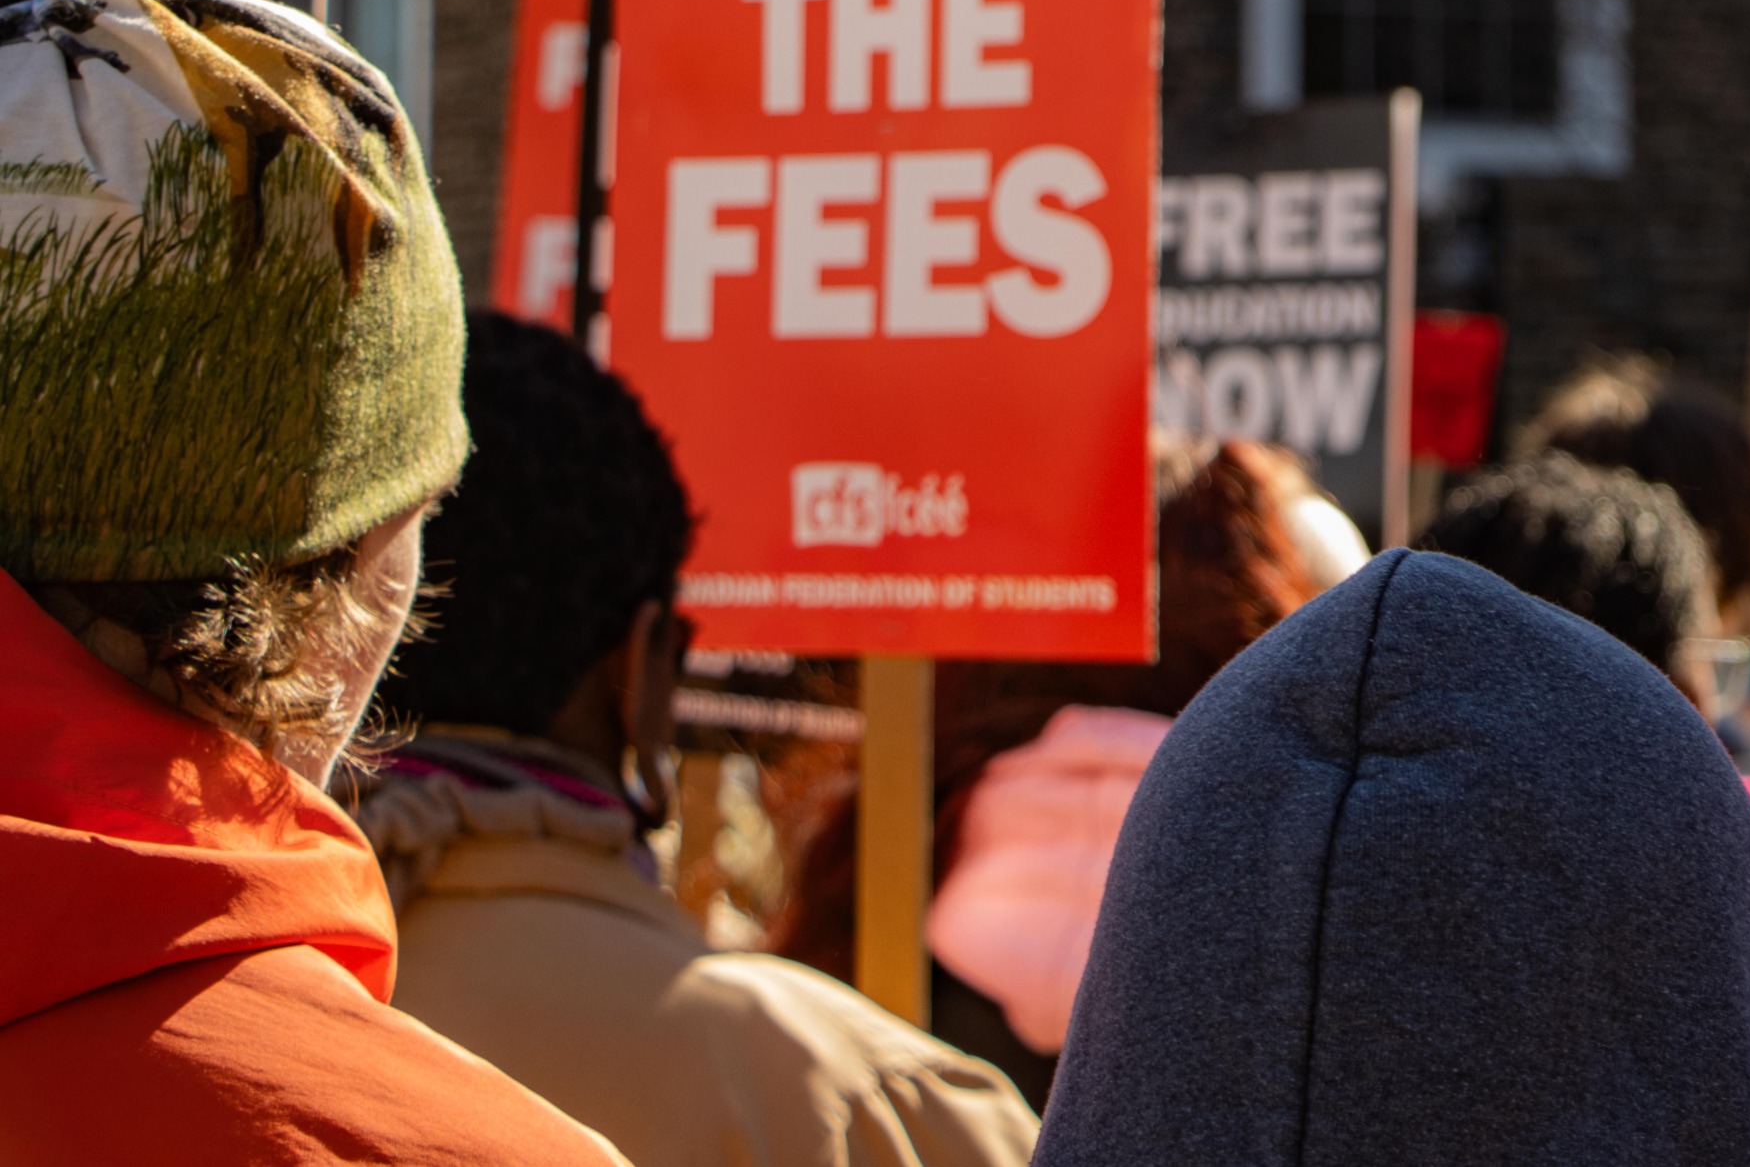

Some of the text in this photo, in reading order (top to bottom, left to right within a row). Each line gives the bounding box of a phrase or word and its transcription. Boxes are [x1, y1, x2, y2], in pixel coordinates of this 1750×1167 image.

[661, 143, 1113, 342] FEES
[782, 571, 938, 610] FEDERATION
[941, 574, 976, 611] OF
[979, 573, 1119, 614] STUDENTS
